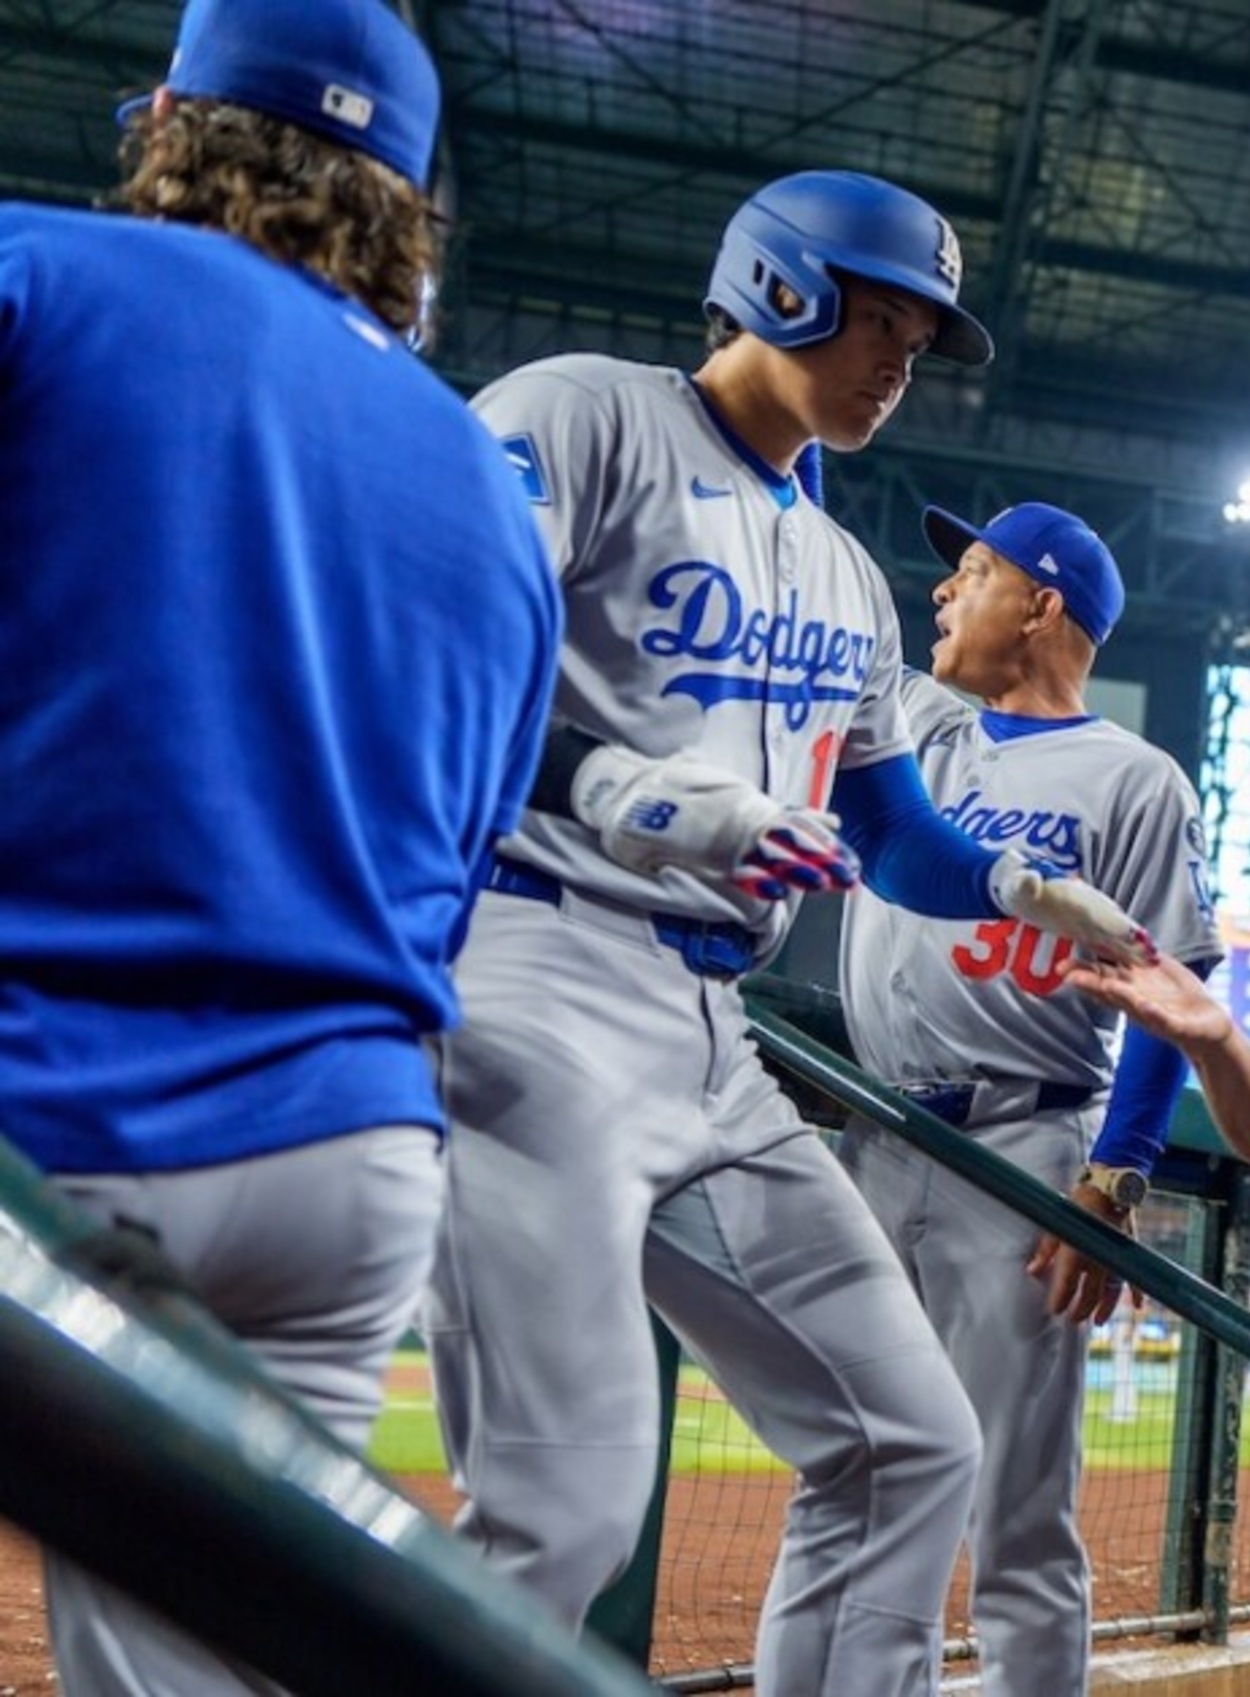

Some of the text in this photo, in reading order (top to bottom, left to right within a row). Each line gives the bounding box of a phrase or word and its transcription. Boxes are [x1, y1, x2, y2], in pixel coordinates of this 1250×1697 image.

[809, 730, 840, 811] 1
[940, 791, 1082, 866] dgers
[951, 918, 1074, 997] 30
